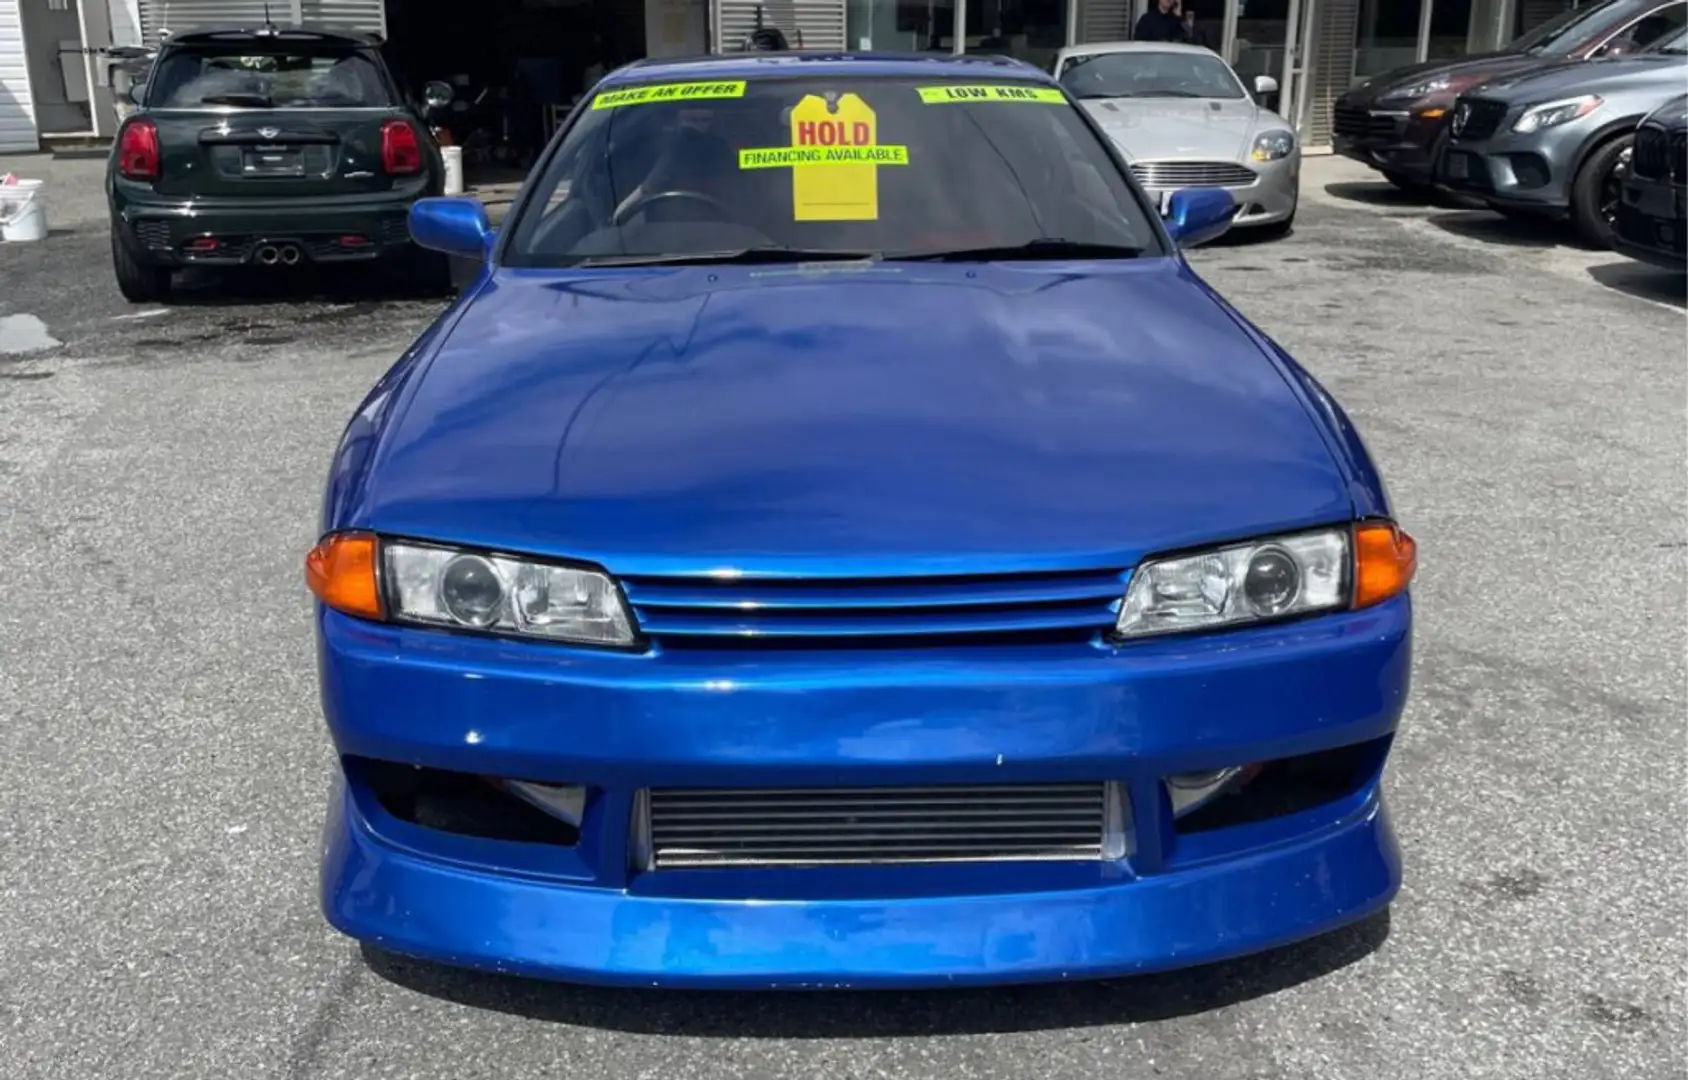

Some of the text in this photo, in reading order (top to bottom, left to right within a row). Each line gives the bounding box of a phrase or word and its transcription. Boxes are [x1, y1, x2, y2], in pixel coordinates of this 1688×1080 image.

[598, 83, 738, 105] MAKE AN OFFER
[944, 87, 1039, 99] LOW KMS
[798, 120, 870, 146] HOLD
[743, 148, 903, 165] FINANCING AVAILABLE
